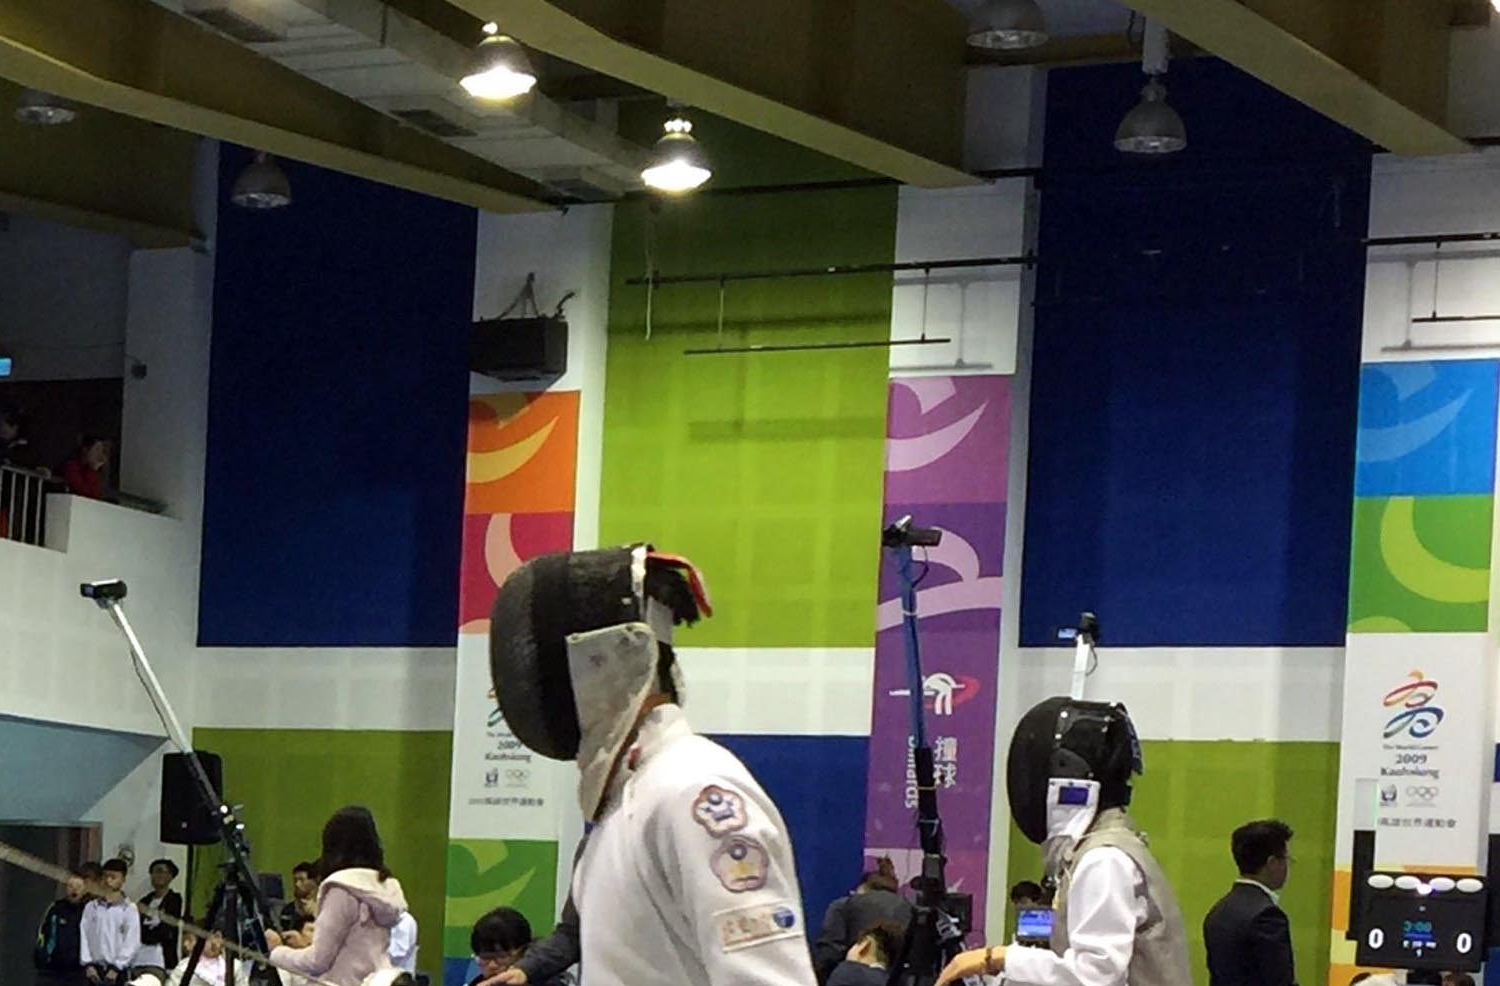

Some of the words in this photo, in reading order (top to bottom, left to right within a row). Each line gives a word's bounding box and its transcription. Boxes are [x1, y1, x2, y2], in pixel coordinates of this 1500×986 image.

[1396, 753, 1427, 764] 2009
[1368, 928, 1384, 949] 0
[1456, 932, 1472, 954] 0
